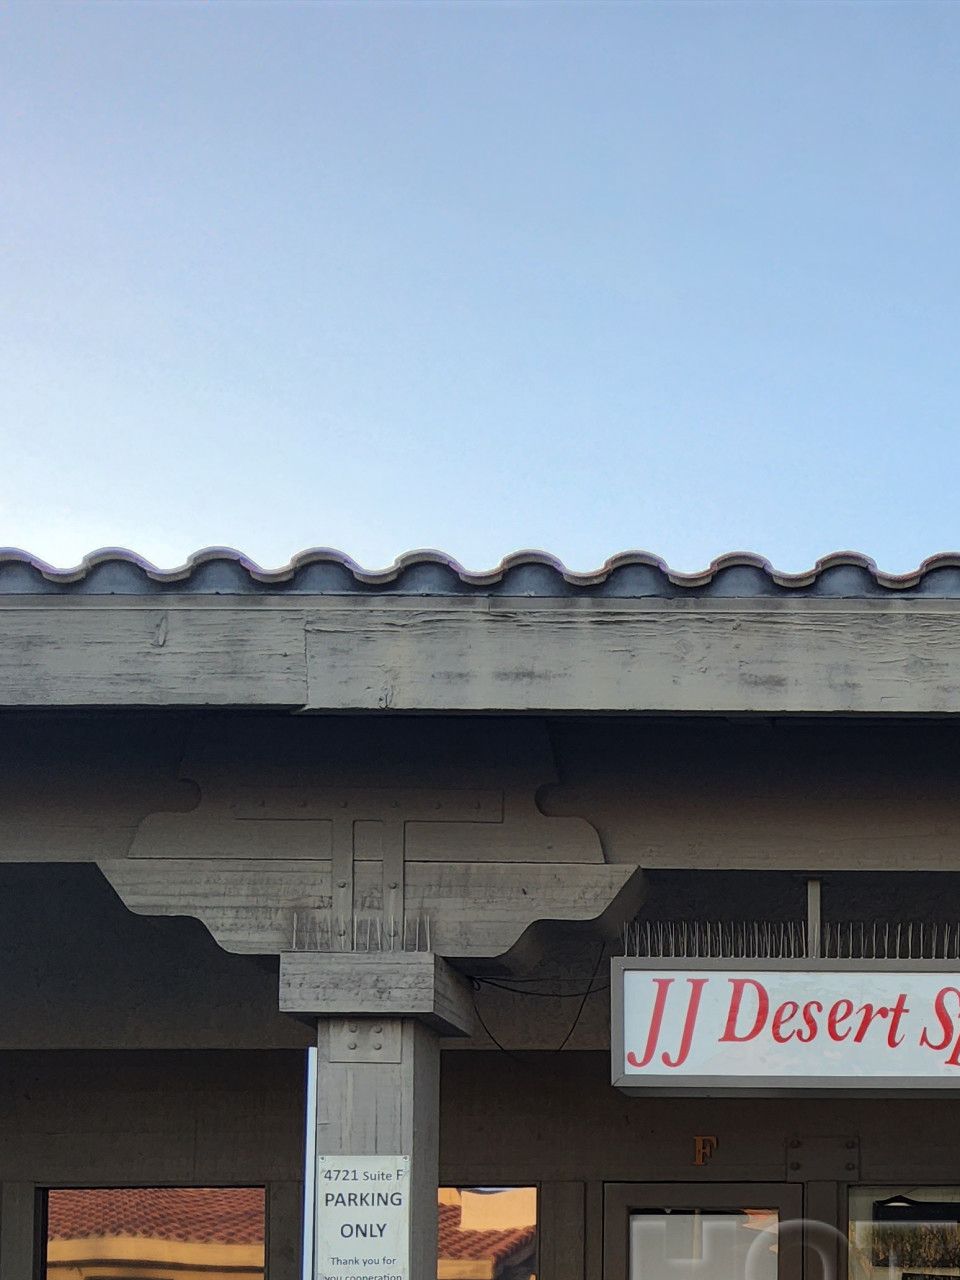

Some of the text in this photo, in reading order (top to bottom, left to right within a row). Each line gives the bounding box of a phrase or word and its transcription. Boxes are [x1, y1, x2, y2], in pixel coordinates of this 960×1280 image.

[627, 978, 709, 1067] JJ
[718, 978, 910, 1048] Desert
[692, 1135, 718, 1167] F
[324, 1169, 404, 1181] 4721 Suite F
[325, 1192, 403, 1207] PARKING
[340, 1223, 387, 1239] ONLY
[330, 1257, 397, 1267] Thank you for
